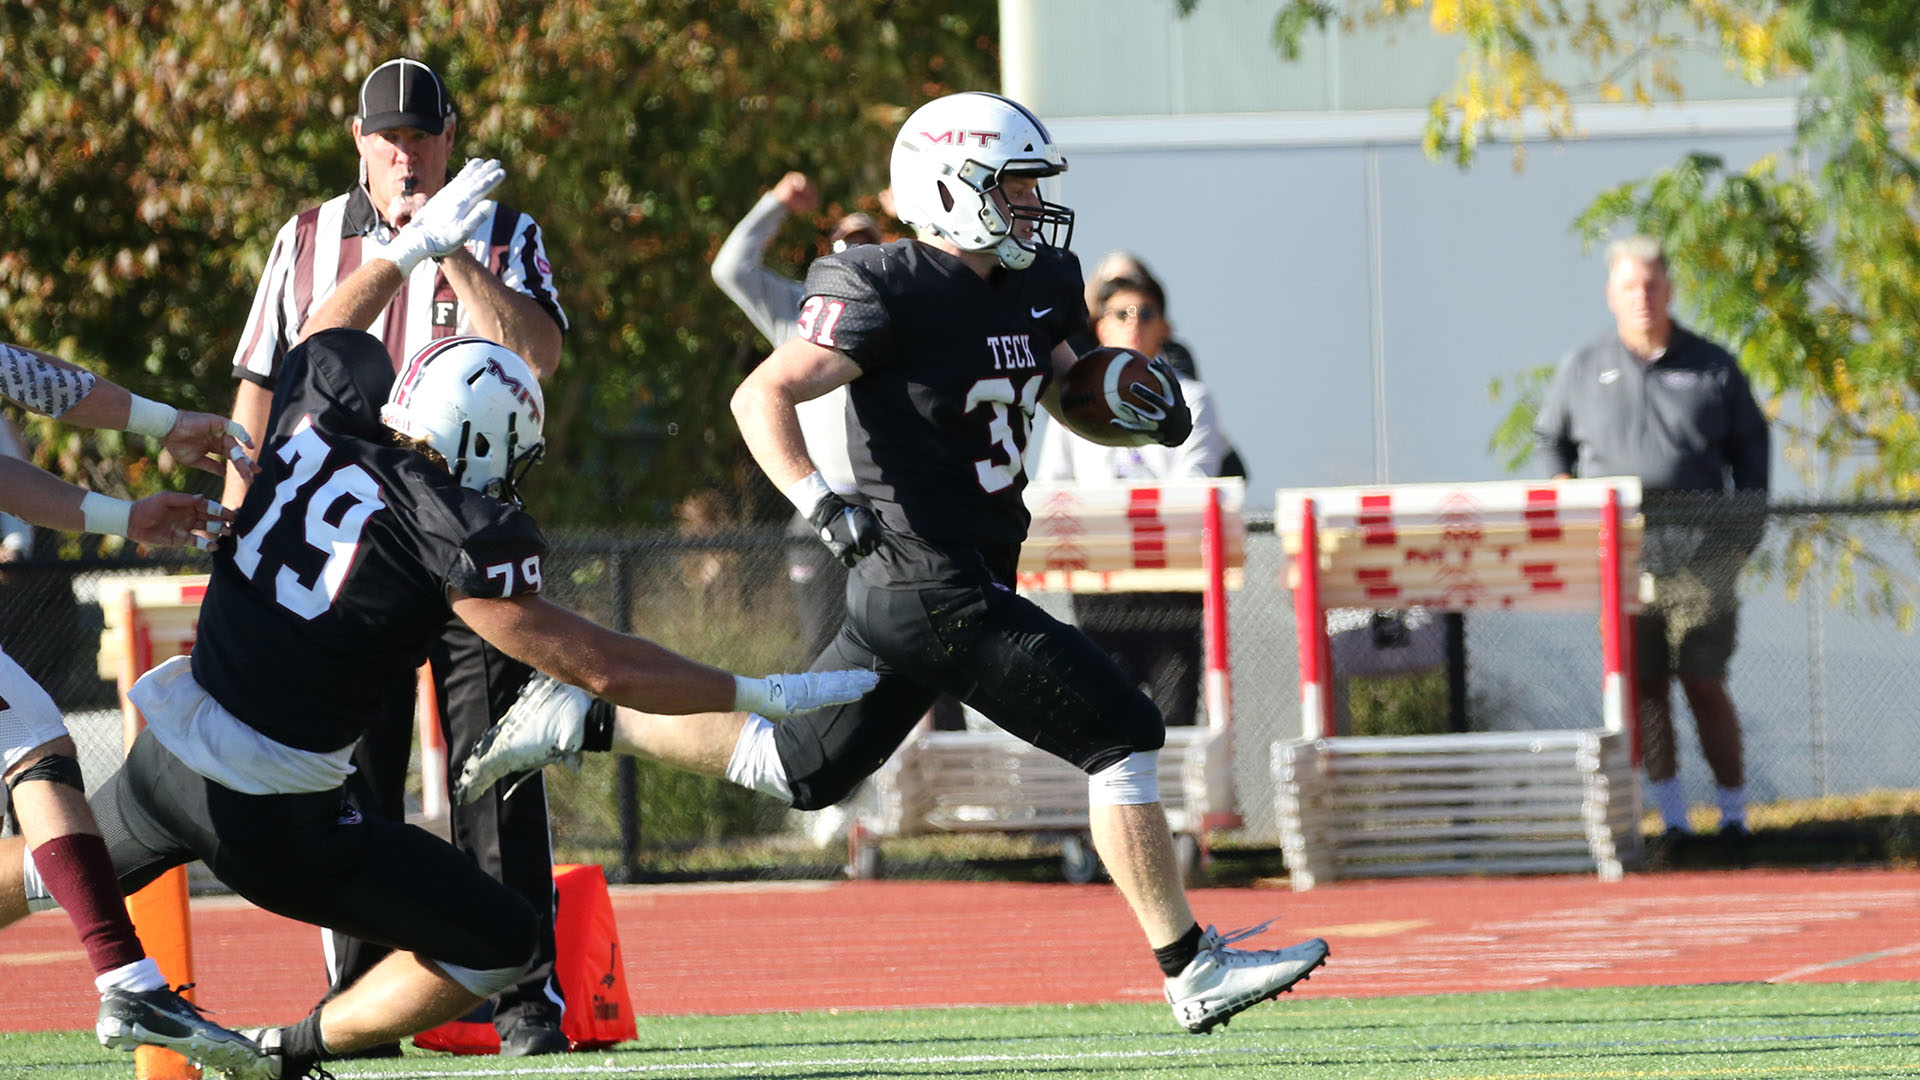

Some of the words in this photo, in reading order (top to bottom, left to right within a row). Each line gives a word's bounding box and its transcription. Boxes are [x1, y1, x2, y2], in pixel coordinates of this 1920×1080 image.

[919, 129, 1000, 148] MIT
[435, 302, 454, 325] F
[797, 295, 845, 348] 31
[987, 334, 1036, 370] TECH
[486, 356, 542, 424] MIT
[963, 373, 1044, 494] 31
[233, 413, 386, 621] 79
[486, 554, 542, 599] 79
